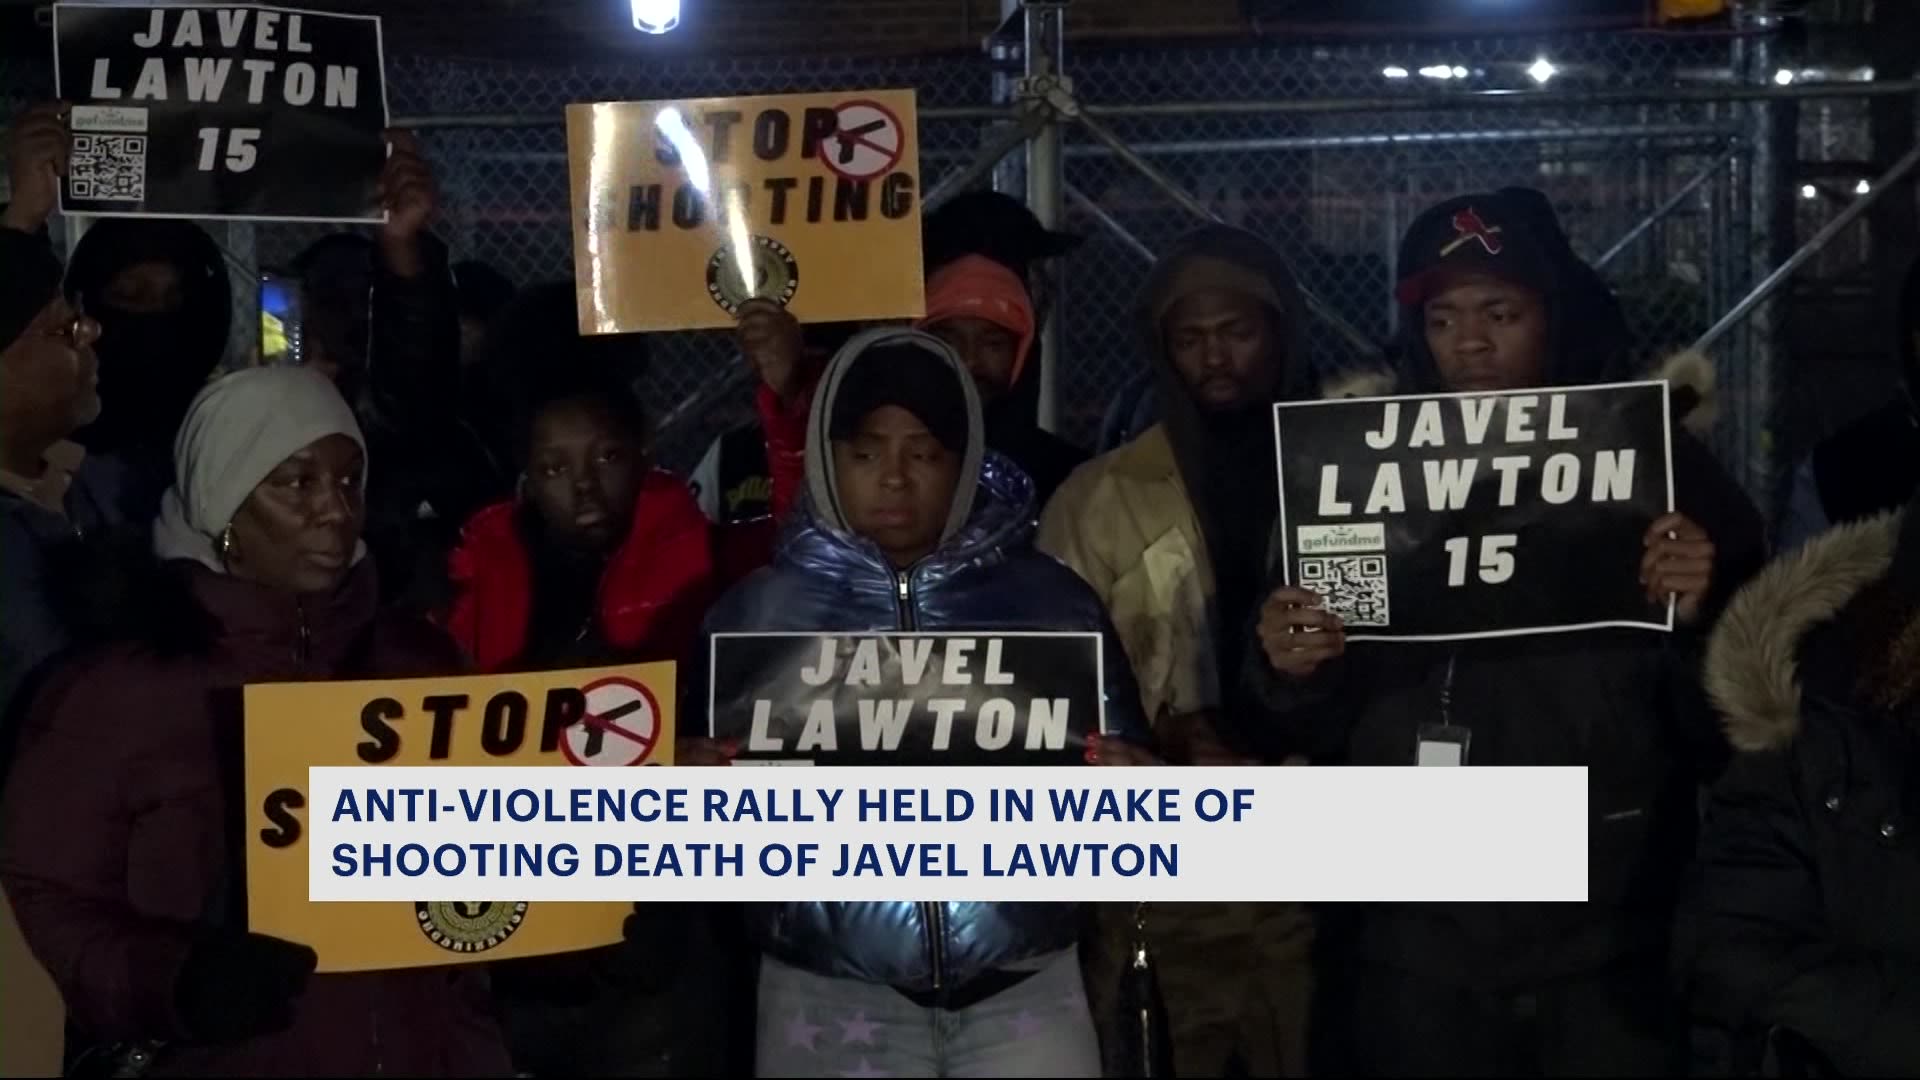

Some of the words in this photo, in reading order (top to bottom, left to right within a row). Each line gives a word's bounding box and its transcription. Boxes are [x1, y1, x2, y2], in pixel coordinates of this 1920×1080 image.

[132, 8, 313, 53] JAVEL
[89, 57, 359, 109] LAWTON
[196, 126, 263, 173] 15
[1364, 393, 1580, 450] JAVEL
[1317, 448, 1637, 517] LAWTON
[1444, 533, 1519, 588] 15
[800, 637, 1016, 687] JAVEL
[356, 687, 588, 764] STOP
[748, 697, 1071, 752] LAWTON
